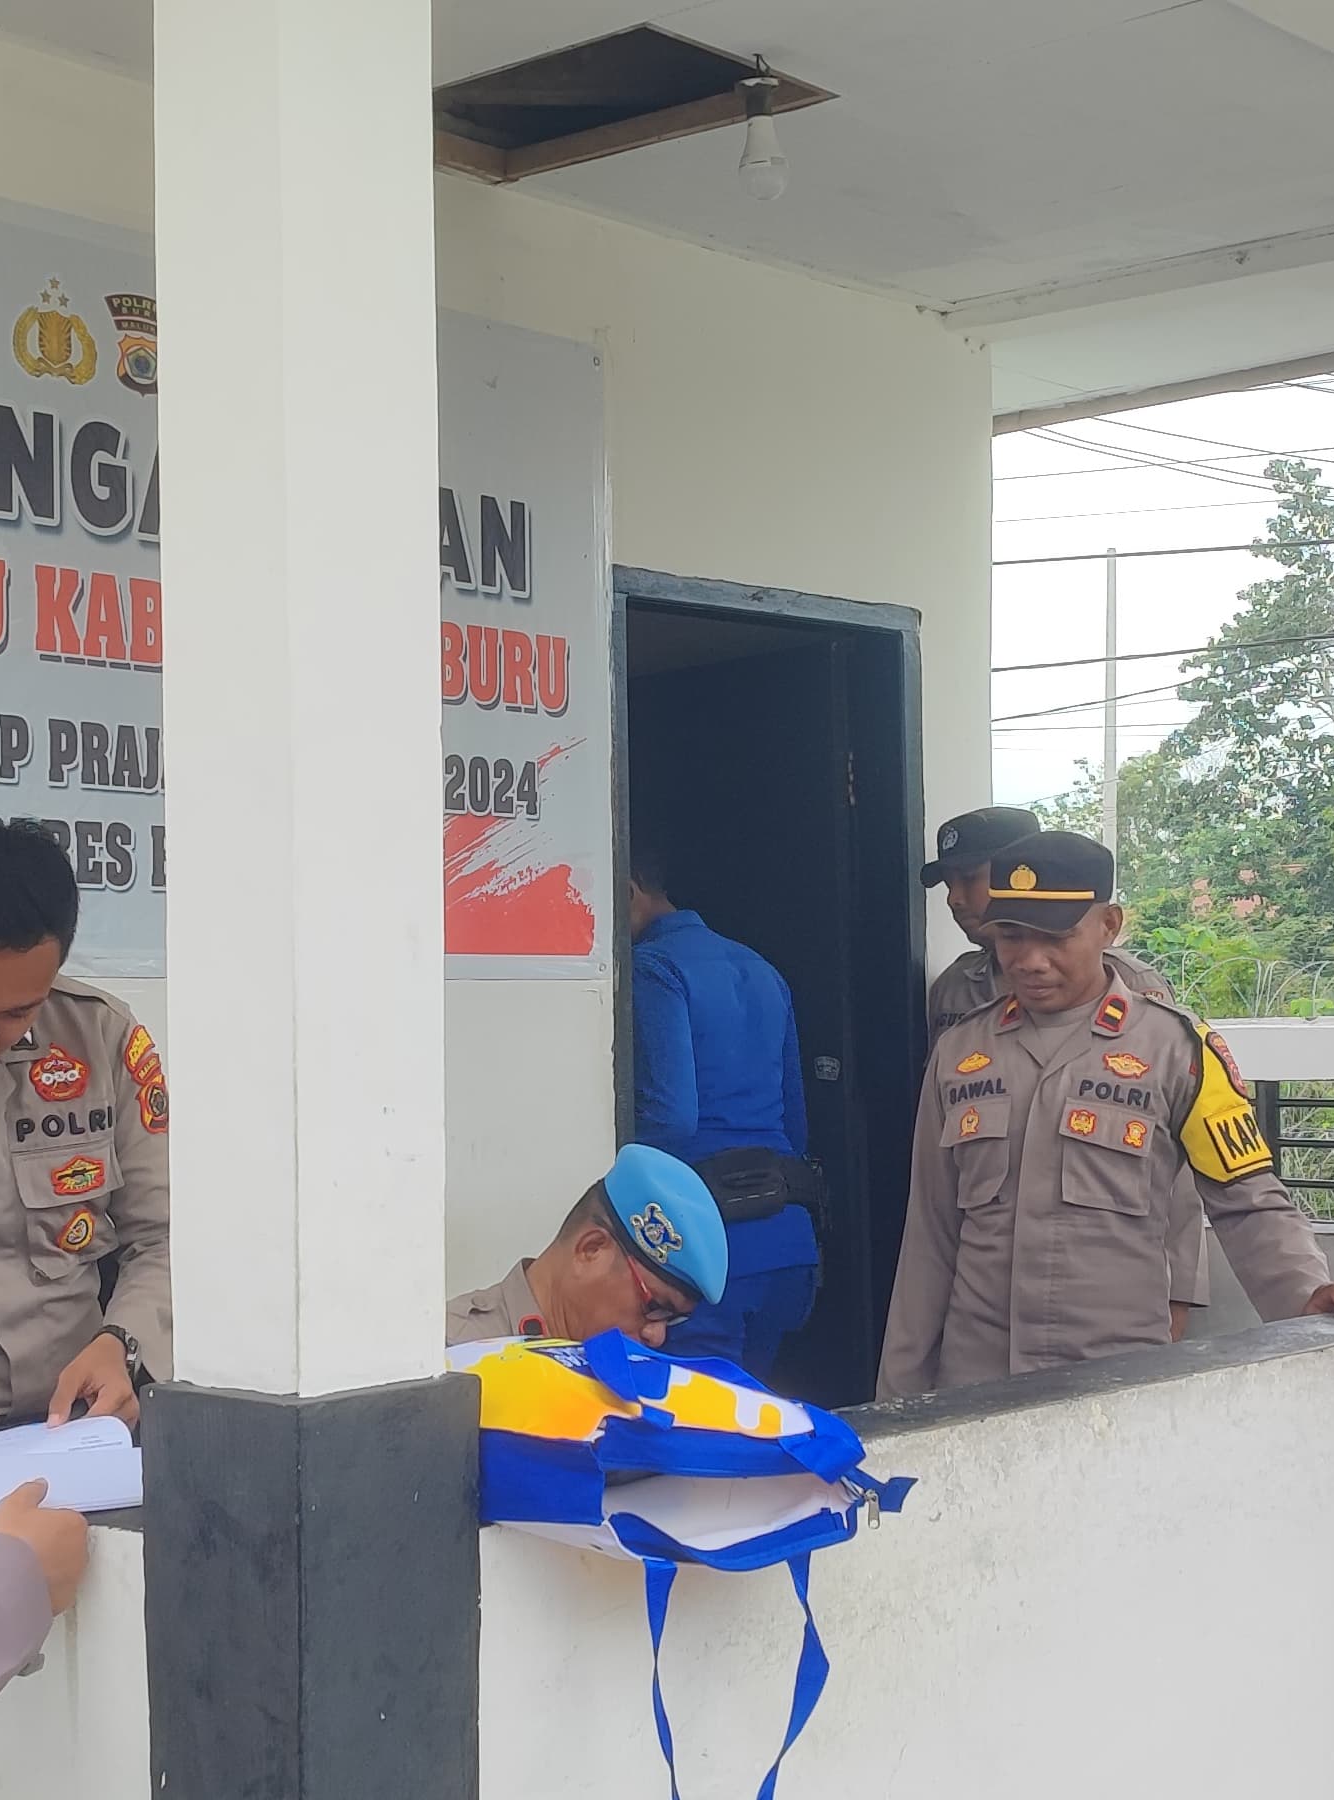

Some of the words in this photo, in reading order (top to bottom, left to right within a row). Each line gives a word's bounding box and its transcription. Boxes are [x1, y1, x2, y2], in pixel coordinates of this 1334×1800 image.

[441, 620, 569, 712] BURU
[47, 717, 163, 791] PRAJ
[444, 754, 539, 817] 2024
[15, 1105, 113, 1142] POLRI
[1079, 1079, 1151, 1110] POLRI
